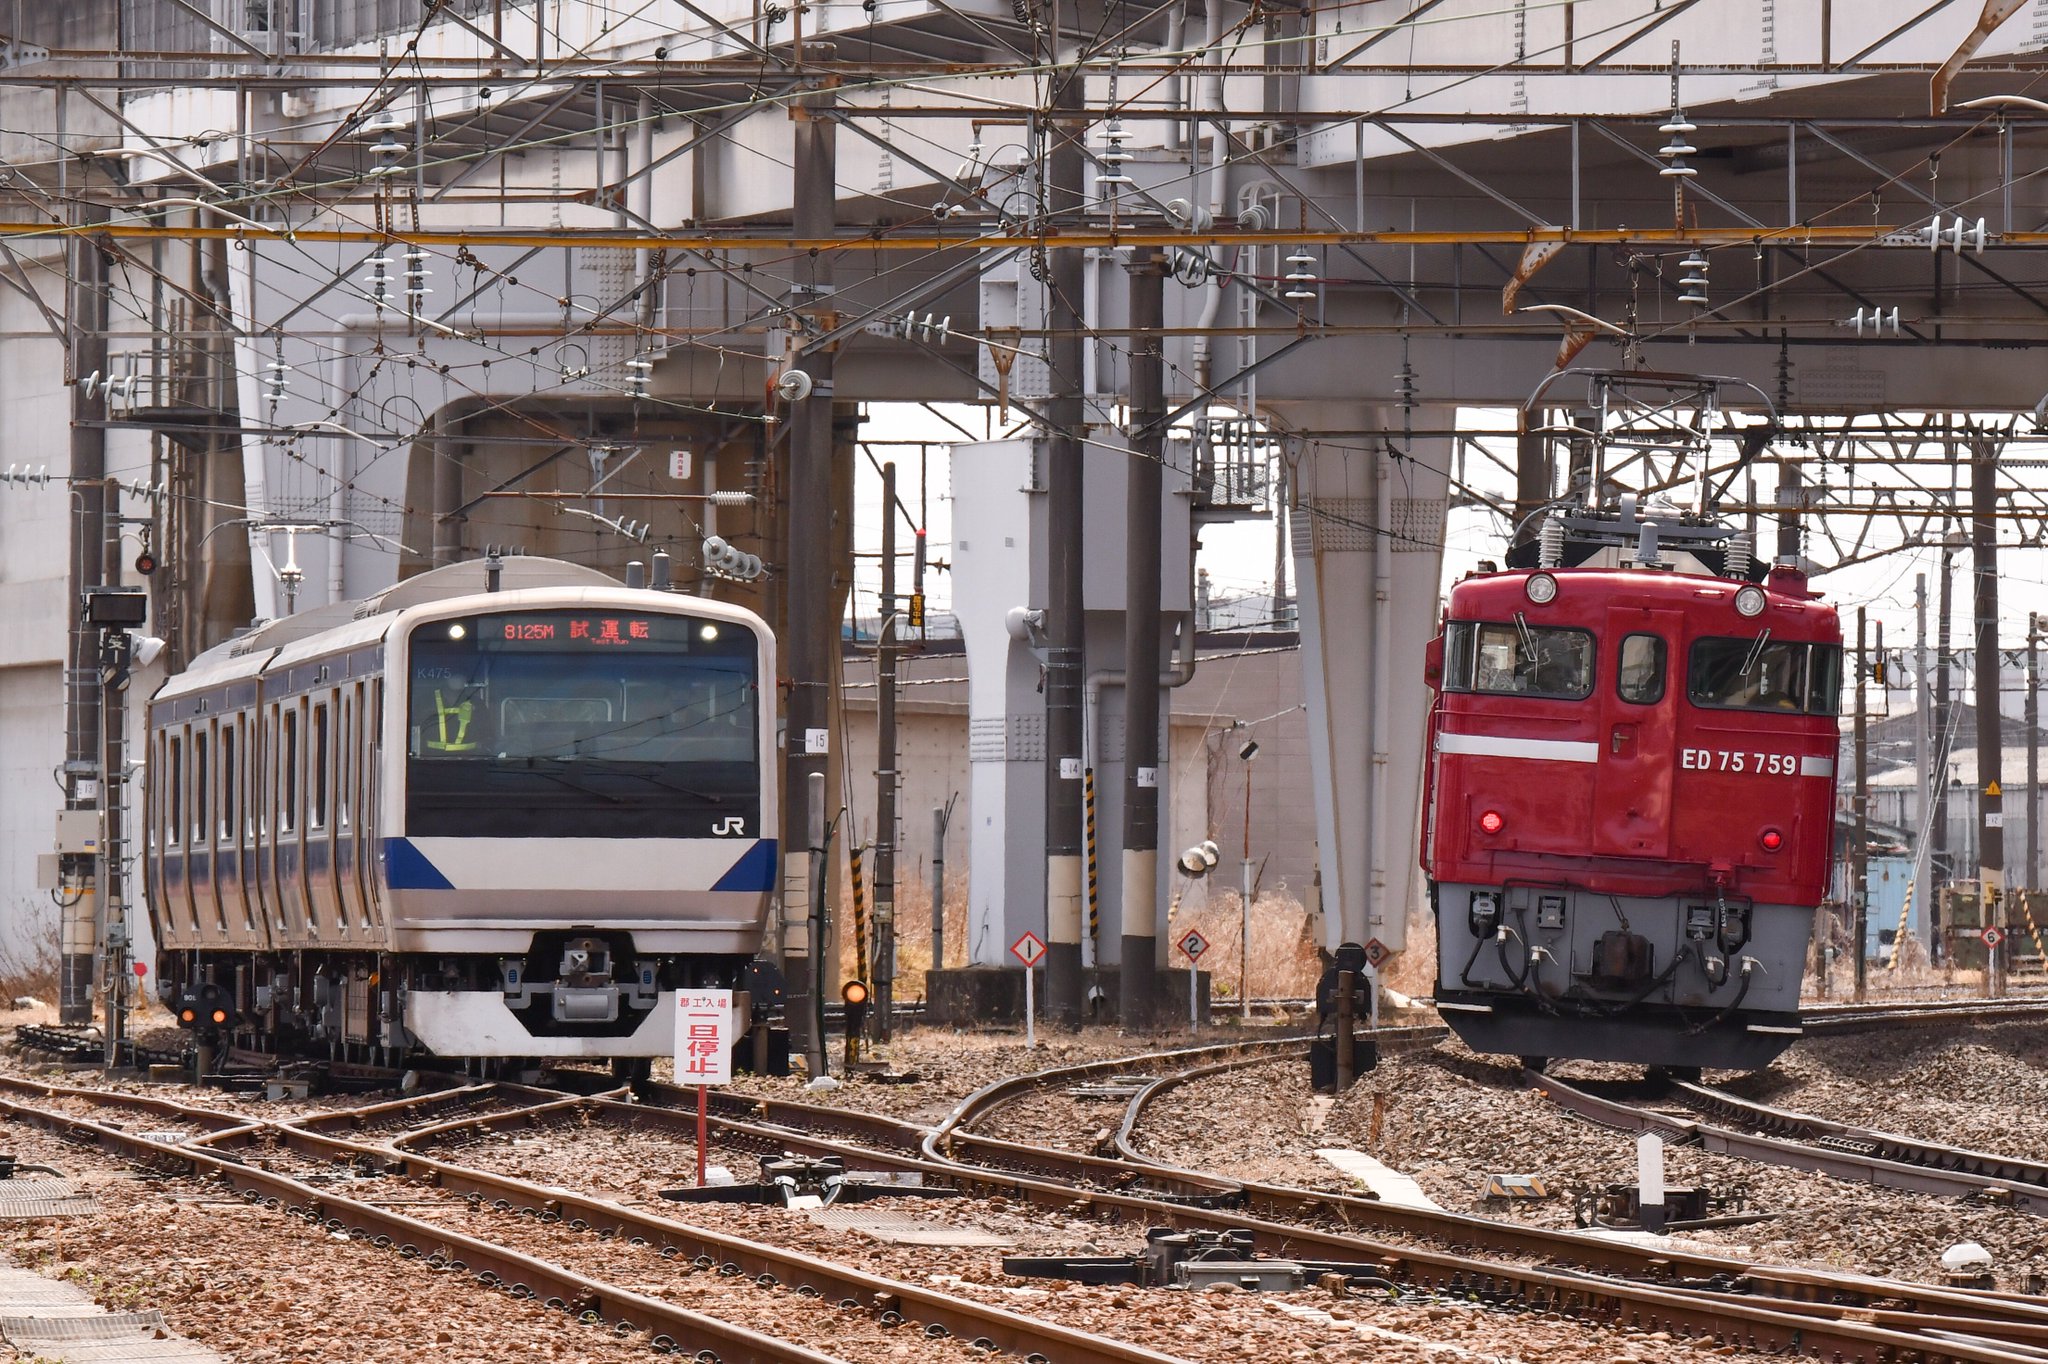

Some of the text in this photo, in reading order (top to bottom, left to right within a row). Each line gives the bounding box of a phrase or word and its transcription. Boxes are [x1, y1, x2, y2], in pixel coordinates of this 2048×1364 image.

[504, 624, 554, 639] 8125M
[570, 620, 648, 638] 試運転
[417, 667, 451, 679] K475
[815, 734, 825, 747] 15
[1069, 763, 1078, 774] 14
[1682, 748, 1796, 776] ED 75 759
[1146, 771, 1155, 783] 14
[712, 816, 745, 836] JR
[1987, 931, 1996, 943] 6
[1188, 937, 1199, 953] 2
[1370, 945, 1380, 960] 3
[680, 997, 727, 1008] 郡工入場
[686, 1013, 719, 1073] 一旦停止
